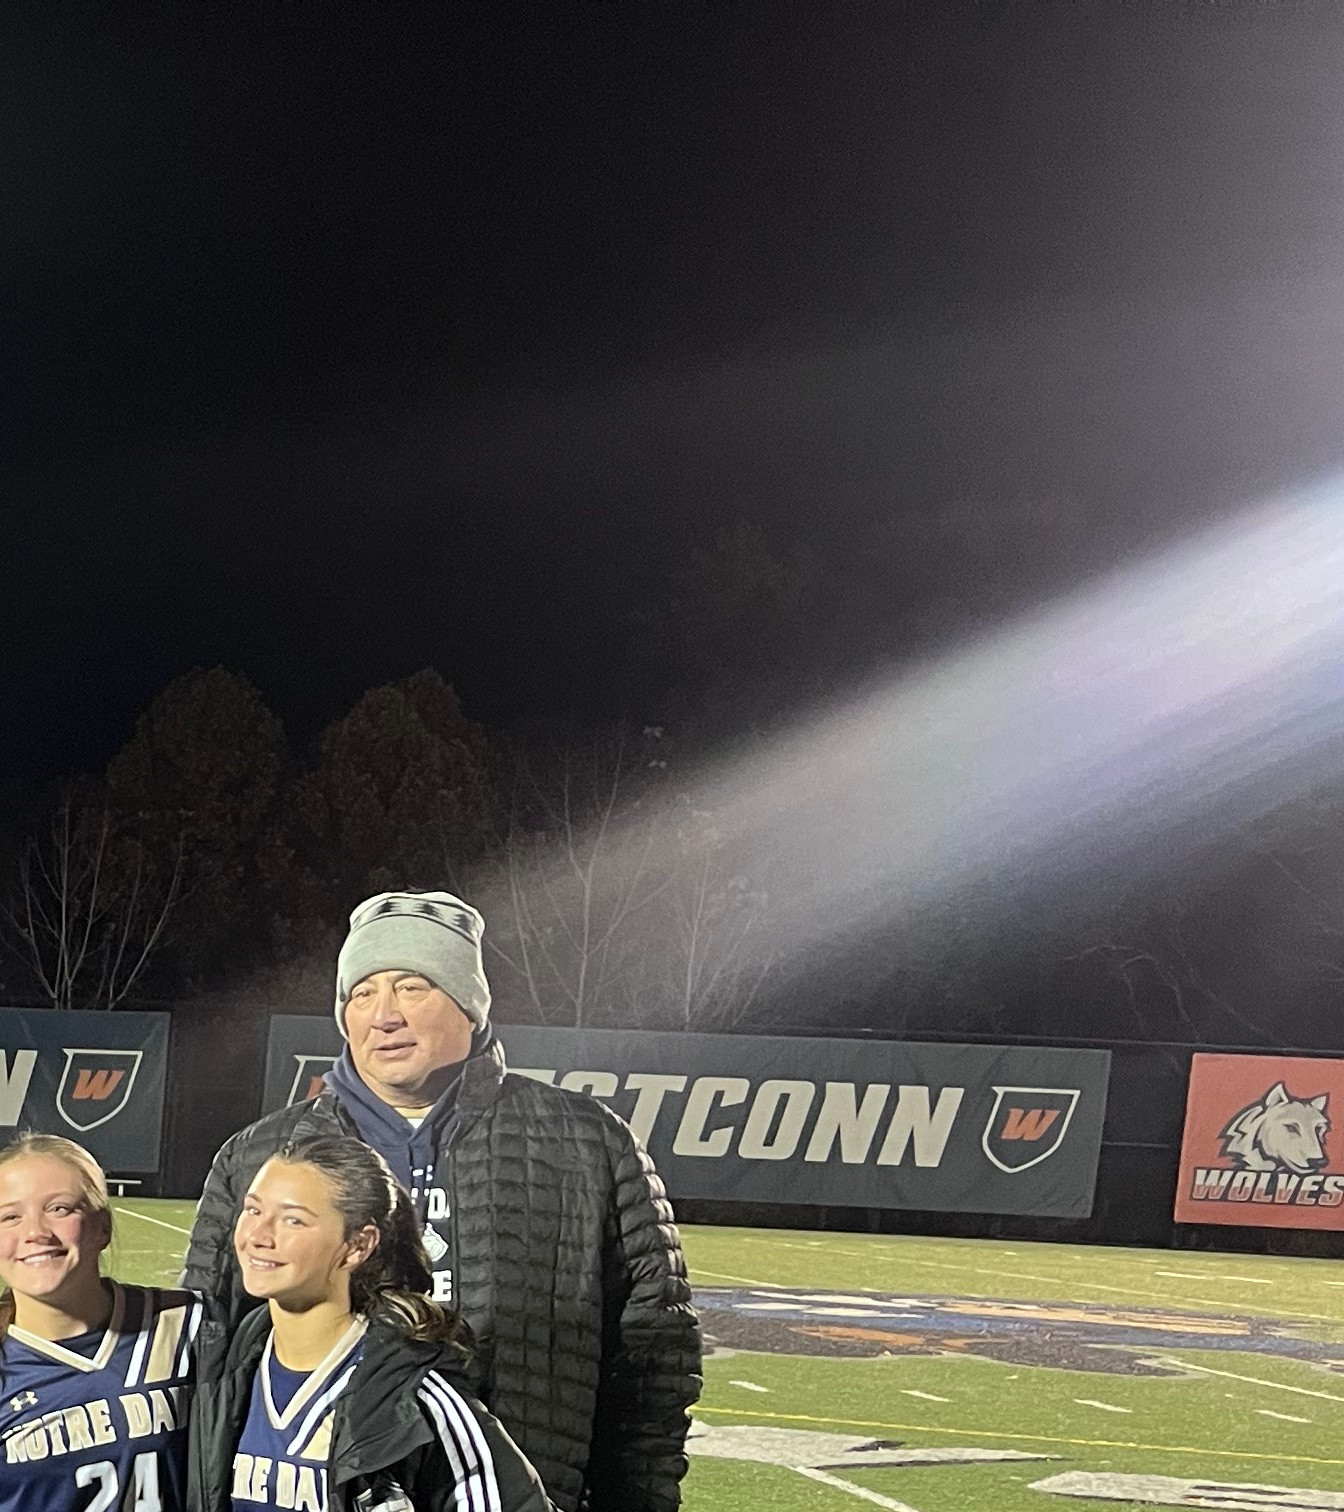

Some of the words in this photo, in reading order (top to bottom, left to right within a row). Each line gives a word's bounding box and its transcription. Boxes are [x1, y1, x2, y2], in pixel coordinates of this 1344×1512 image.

[72, 1068, 125, 1101] W
[507, 1068, 965, 1168] TCONN
[1000, 1107, 1061, 1142] W
[1191, 1167, 1344, 1207] WOLVES
[1, 1398, 117, 1465] NOTRE
[118, 1384, 190, 1439] DA
